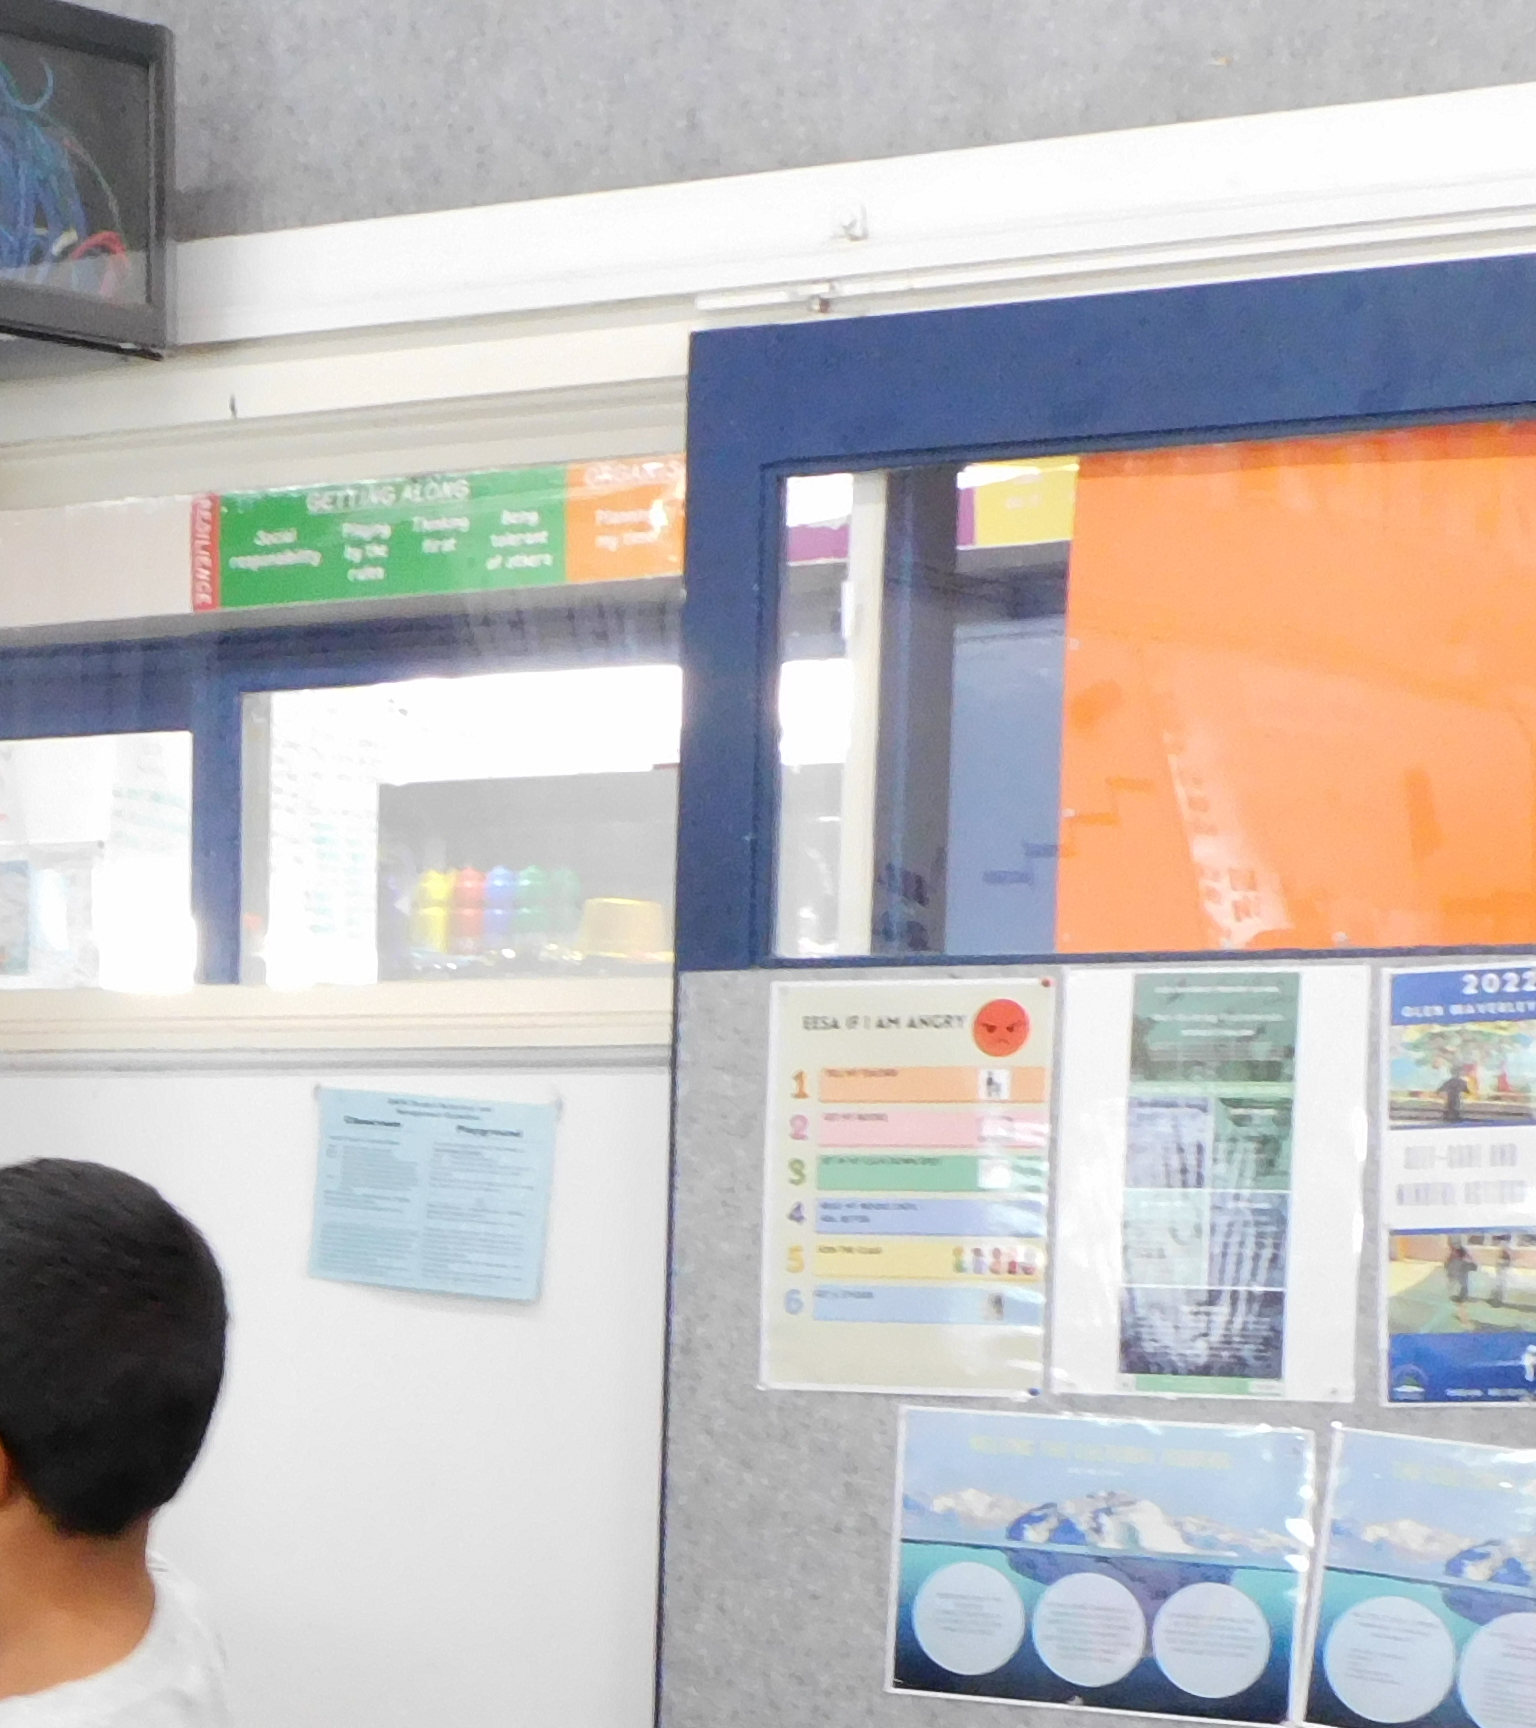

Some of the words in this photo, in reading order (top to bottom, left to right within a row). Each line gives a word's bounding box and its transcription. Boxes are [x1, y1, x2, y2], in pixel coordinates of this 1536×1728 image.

[791, 1069, 811, 1100] 1
[789, 1113, 810, 1141] 2
[787, 1157, 807, 1186] 3
[786, 1200, 807, 1225] 4
[785, 1244, 806, 1274] 5
[783, 1288, 805, 1316] 6
